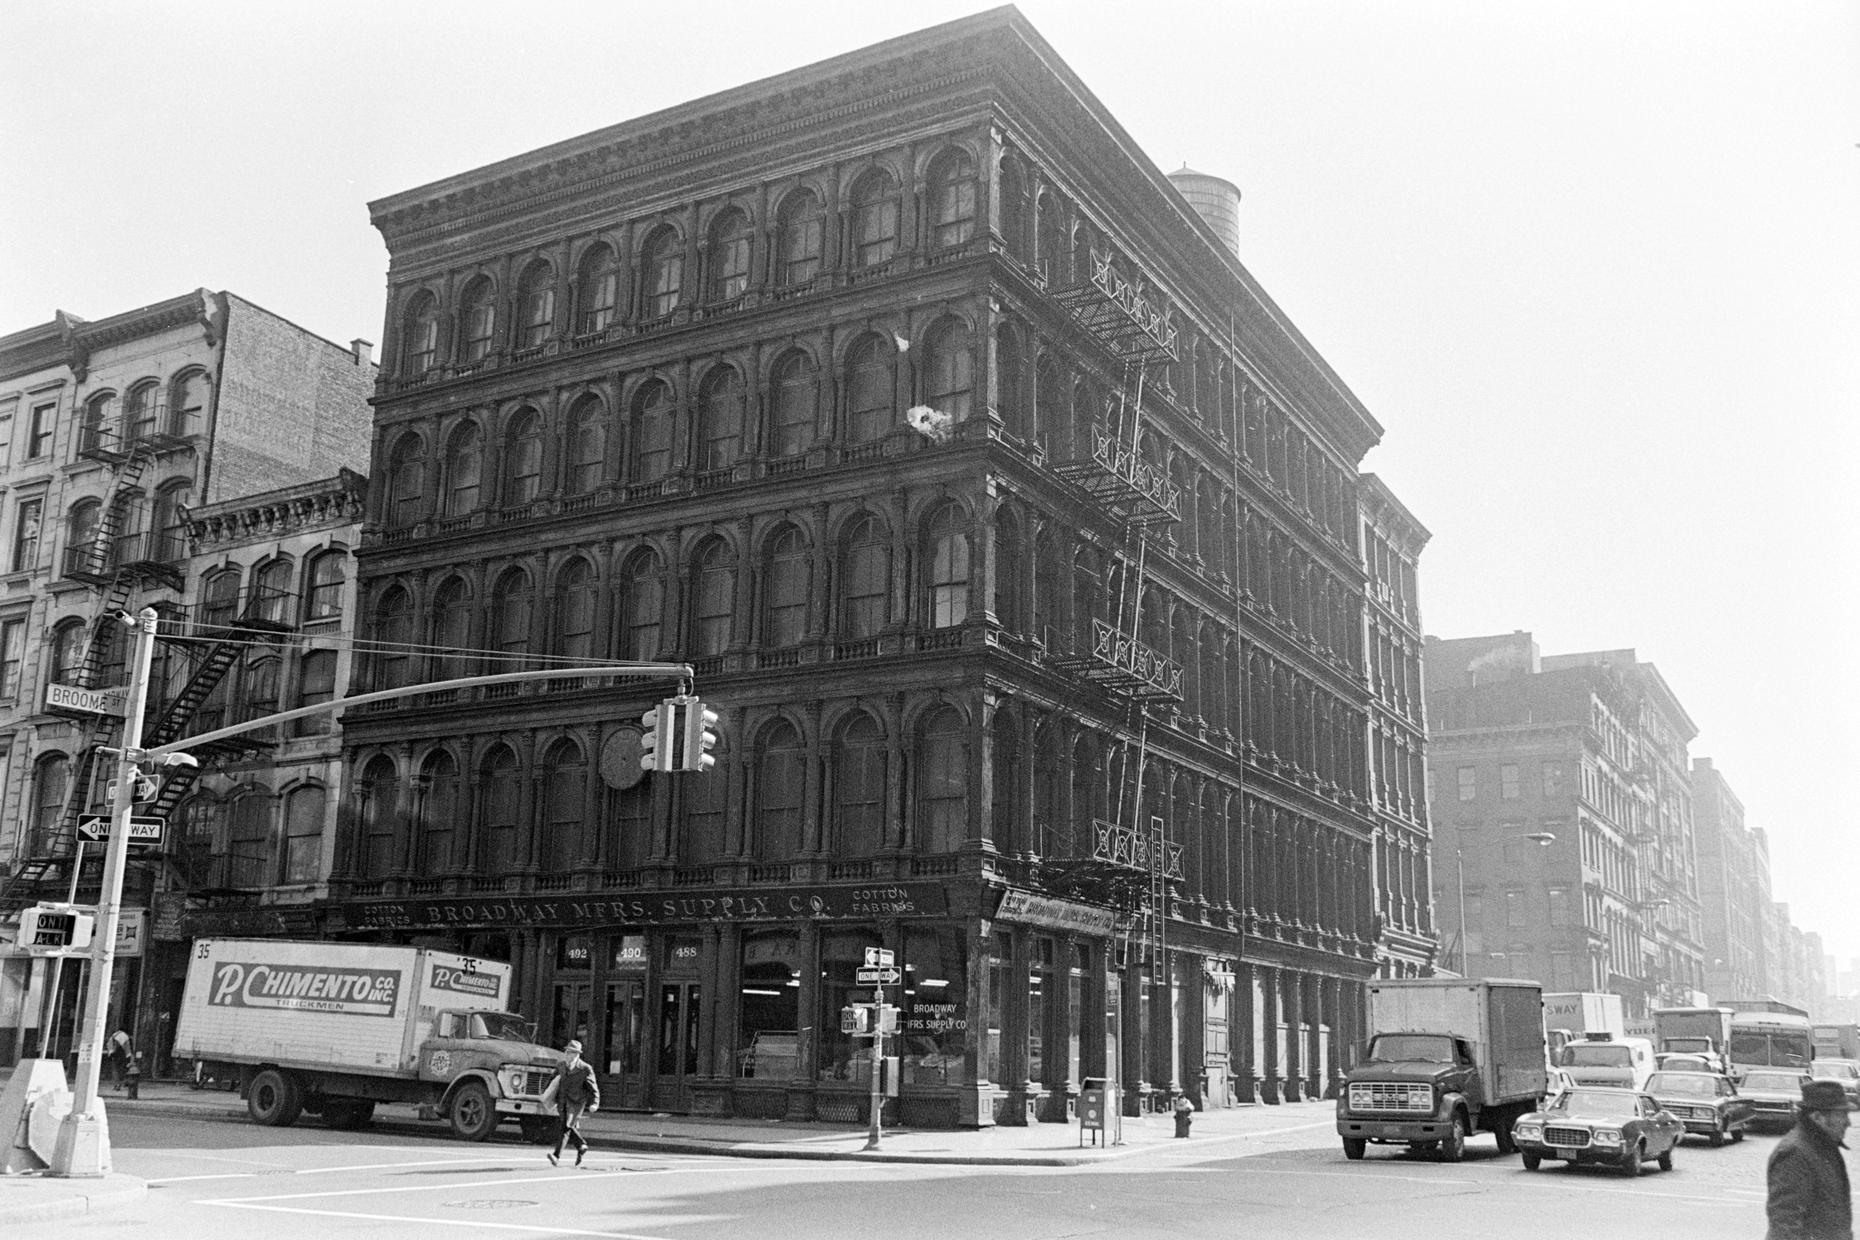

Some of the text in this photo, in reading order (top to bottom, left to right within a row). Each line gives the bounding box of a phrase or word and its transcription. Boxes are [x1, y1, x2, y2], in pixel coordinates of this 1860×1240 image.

[53, 687, 107, 711] BROOME
[131, 825, 156, 836] WAY
[852, 888, 908, 900] COTTON
[427, 903, 558, 922] BROADWAY
[663, 896, 770, 916] SUPPLY
[36, 933, 63, 945] ALK
[198, 943, 211, 959] 35
[568, 948, 588, 960] 492
[621, 947, 641, 959] 490
[676, 947, 697, 958] 488
[461, 957, 477, 976] 35
[881, 971, 895, 980] WAY
[242, 966, 373, 1005] CHIMENTO
[275, 998, 345, 1011] TRUCKMEN
[913, 1003, 957, 1014] BROADWAY
[926, 1019, 954, 1029] SUPPLY
